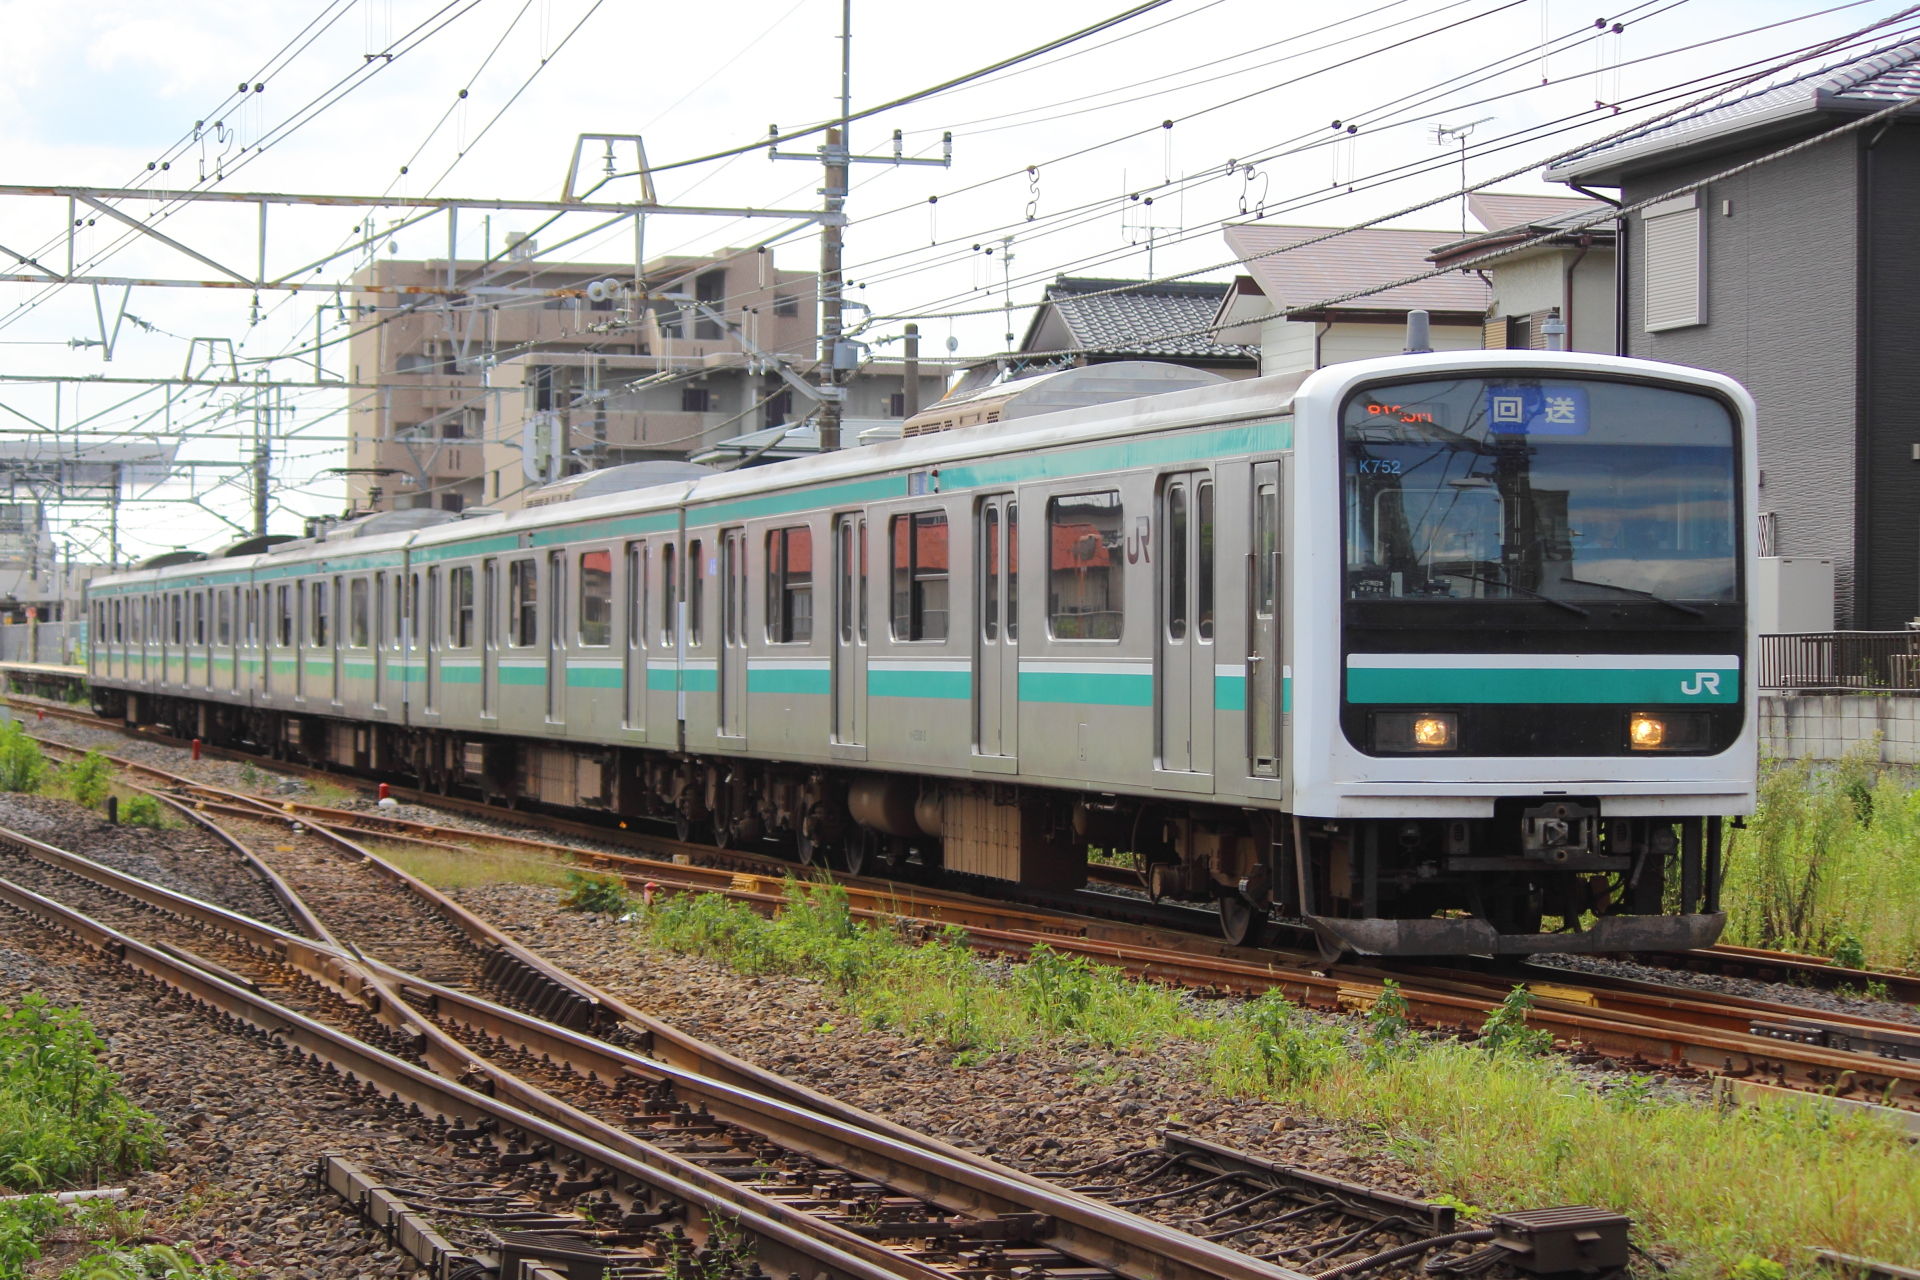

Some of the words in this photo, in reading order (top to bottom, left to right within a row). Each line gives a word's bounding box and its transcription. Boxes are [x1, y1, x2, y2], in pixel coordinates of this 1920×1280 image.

[1493, 396, 1576, 424] 回送
[1359, 460, 1401, 474] K752
[1126, 515, 1151, 565] JR
[1681, 672, 1720, 695] JR
